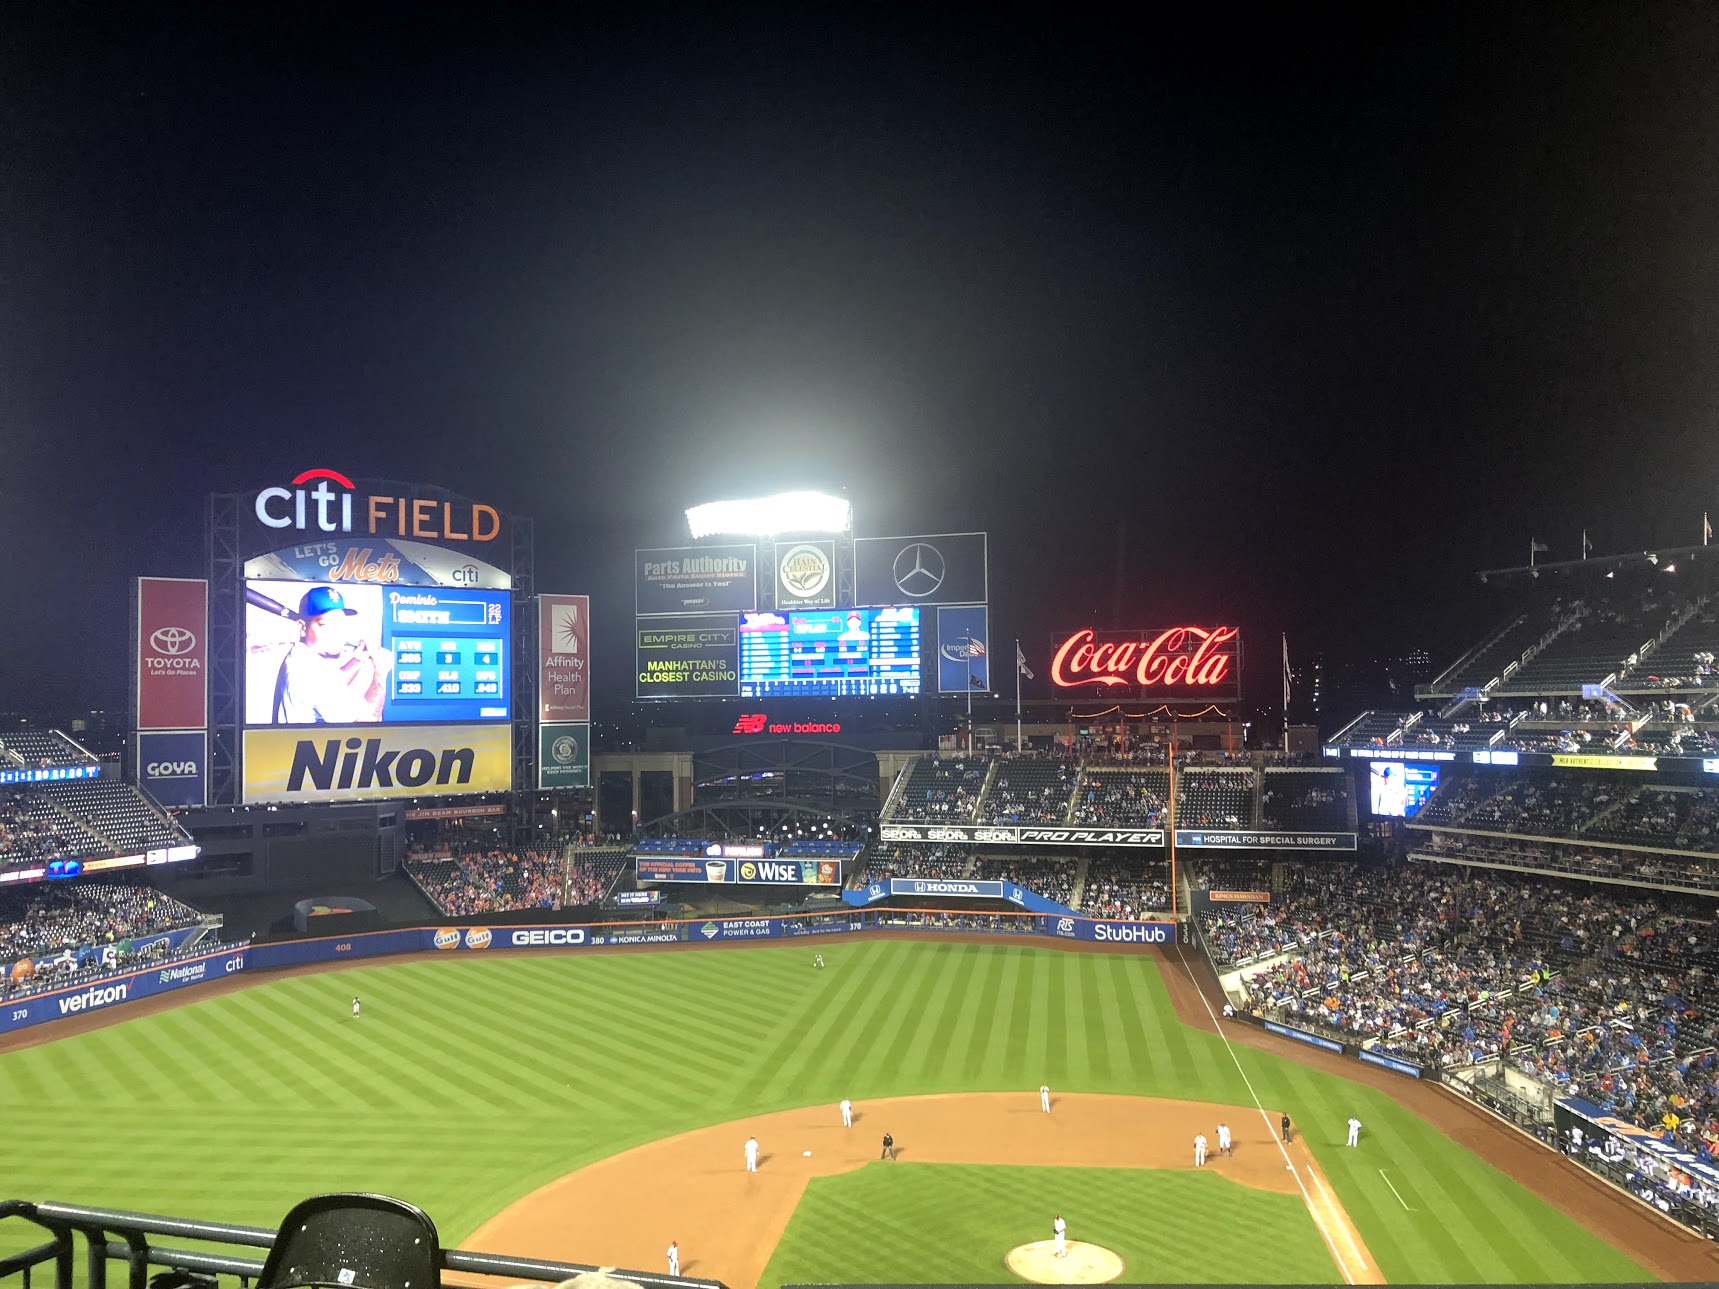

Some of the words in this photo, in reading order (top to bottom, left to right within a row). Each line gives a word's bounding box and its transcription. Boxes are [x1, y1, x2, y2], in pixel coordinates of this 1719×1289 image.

[255, 480, 352, 533] citi
[368, 495, 500, 541] FIELD
[295, 543, 337, 558] LET'S
[318, 554, 340, 567] GO
[328, 547, 402, 581] Mets
[644, 560, 680, 576] Parts
[682, 555, 747, 575] Authority
[793, 558, 816, 566] HAIN
[452, 566, 479, 583] citi
[783, 564, 826, 574] CELESTIAL
[389, 592, 438, 606] Dominic
[488, 603, 502, 613] 22
[488, 614, 502, 624] LF
[643, 634, 696, 643] EMPIRE
[698, 633, 730, 642] CITY
[545, 655, 585, 670] Affinity
[1051, 626, 1239, 687] Coca-Cola
[145, 657, 201, 669] TOYOTA
[647, 659, 728, 672] MANHATTAN'S
[548, 671, 582, 682] Health
[639, 672, 690, 683] CLOSEST
[692, 670, 737, 682] CASINO
[554, 683, 576, 695] Plan
[768, 723, 792, 733] new
[793, 722, 841, 733] balance
[147, 761, 197, 776] GOYA
[286, 737, 475, 791] Nikon
[1020, 831, 1069, 841] PRO
[1070, 832, 1161, 843] PLAYER
[1203, 835, 1241, 844] HOSPITAL
[1242, 836, 1258, 844] FOR
[1259, 836, 1295, 844] SPECIAL
[1296, 836, 1337, 845] SURGERY
[758, 862, 796, 881] WISE
[927, 883, 979, 893] HONDA
[868, 891, 886, 902] HONDA
[723, 921, 743, 929] EAST
[744, 920, 770, 928] COAST
[850, 922, 862, 931] 370
[1057, 918, 1075, 931] RTS
[435, 932, 458, 945] Gulf
[467, 932, 490, 944] Gulf
[511, 929, 585, 946] GEICO
[723, 929, 749, 937] POWER
[755, 928, 771, 936] GAS
[1094, 924, 1166, 943] StubHub
[590, 936, 605, 945] 380
[618, 935, 646, 944] KONICA
[646, 934, 678, 943] MINOLTA
[335, 943, 352, 952] 408
[225, 956, 244, 972] citi
[170, 962, 206, 981] National
[58, 983, 127, 1014] verizon
[12, 1009, 28, 1021] 370
